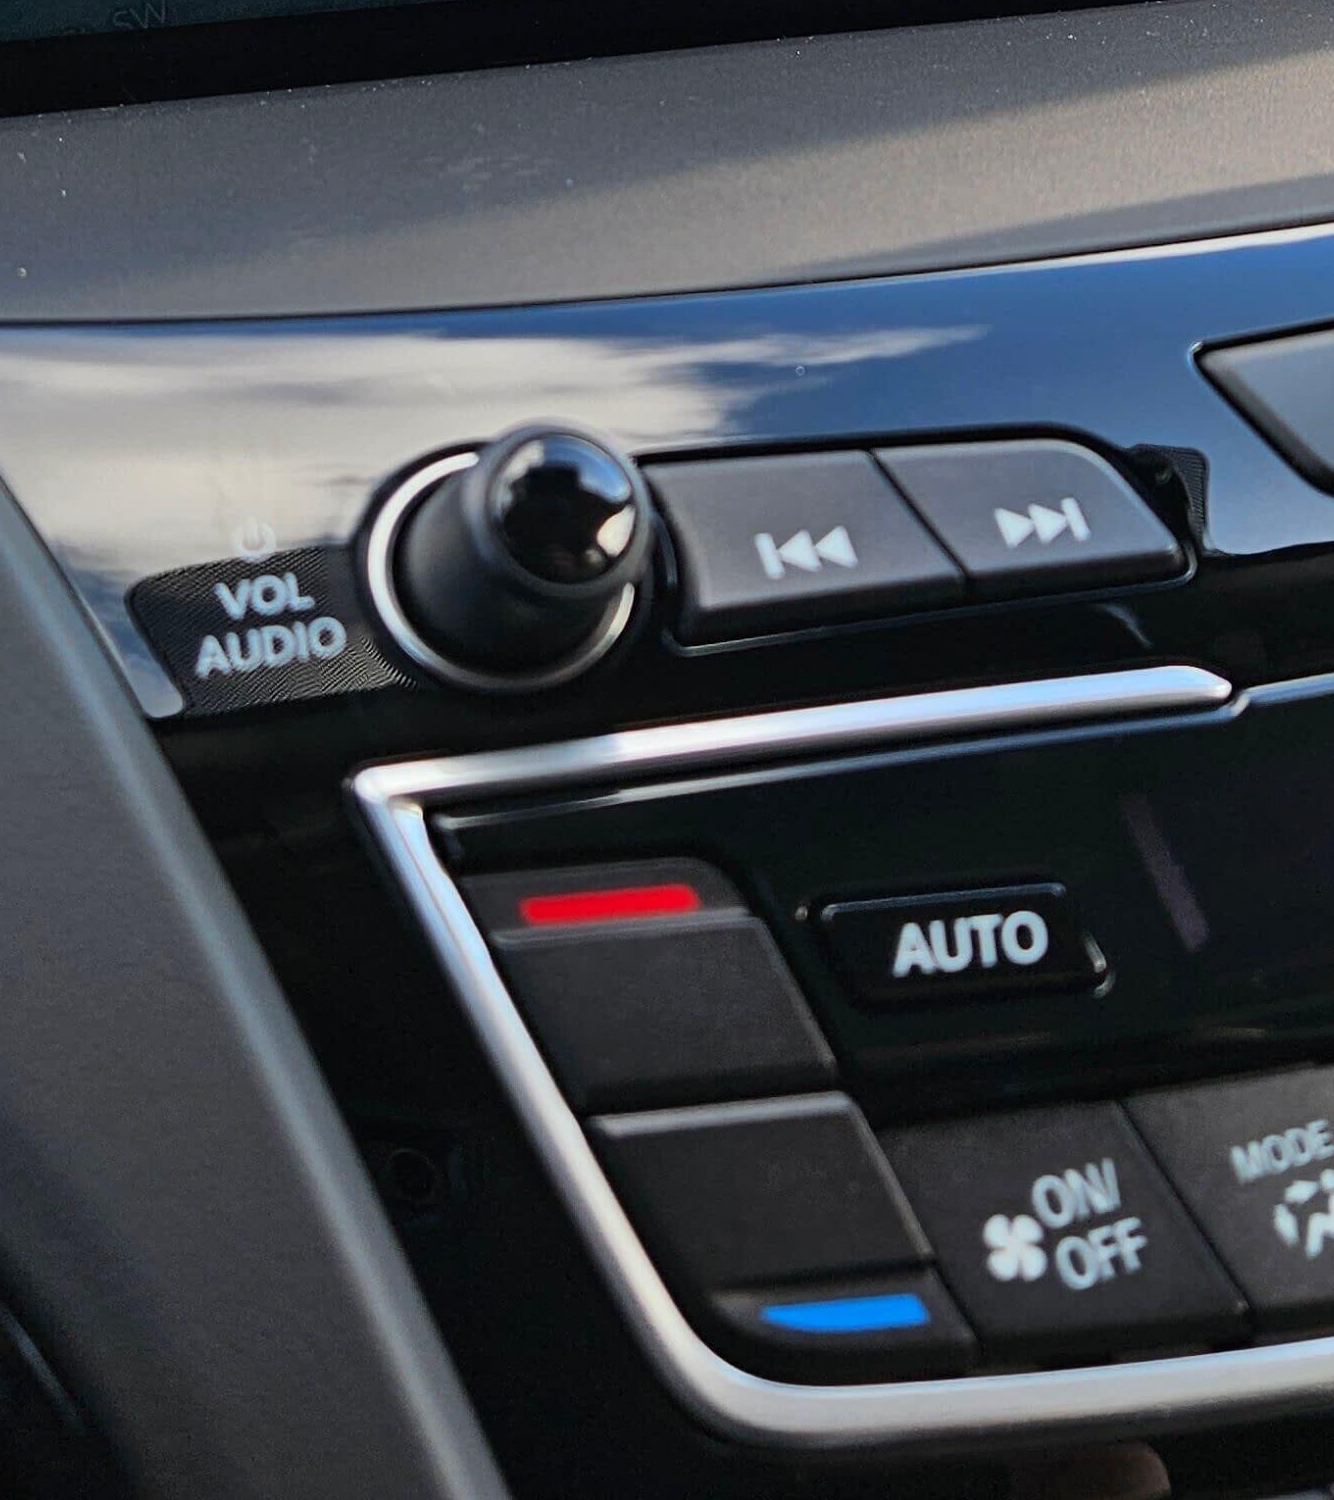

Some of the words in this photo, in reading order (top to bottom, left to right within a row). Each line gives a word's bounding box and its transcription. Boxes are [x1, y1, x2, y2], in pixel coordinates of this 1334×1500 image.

[214, 572, 316, 620] VOL
[195, 617, 347, 678] AUDIO
[891, 910, 1049, 978] AUTO
[1032, 1157, 1121, 1229] ON/
[1055, 1217, 1148, 1290] OFF
